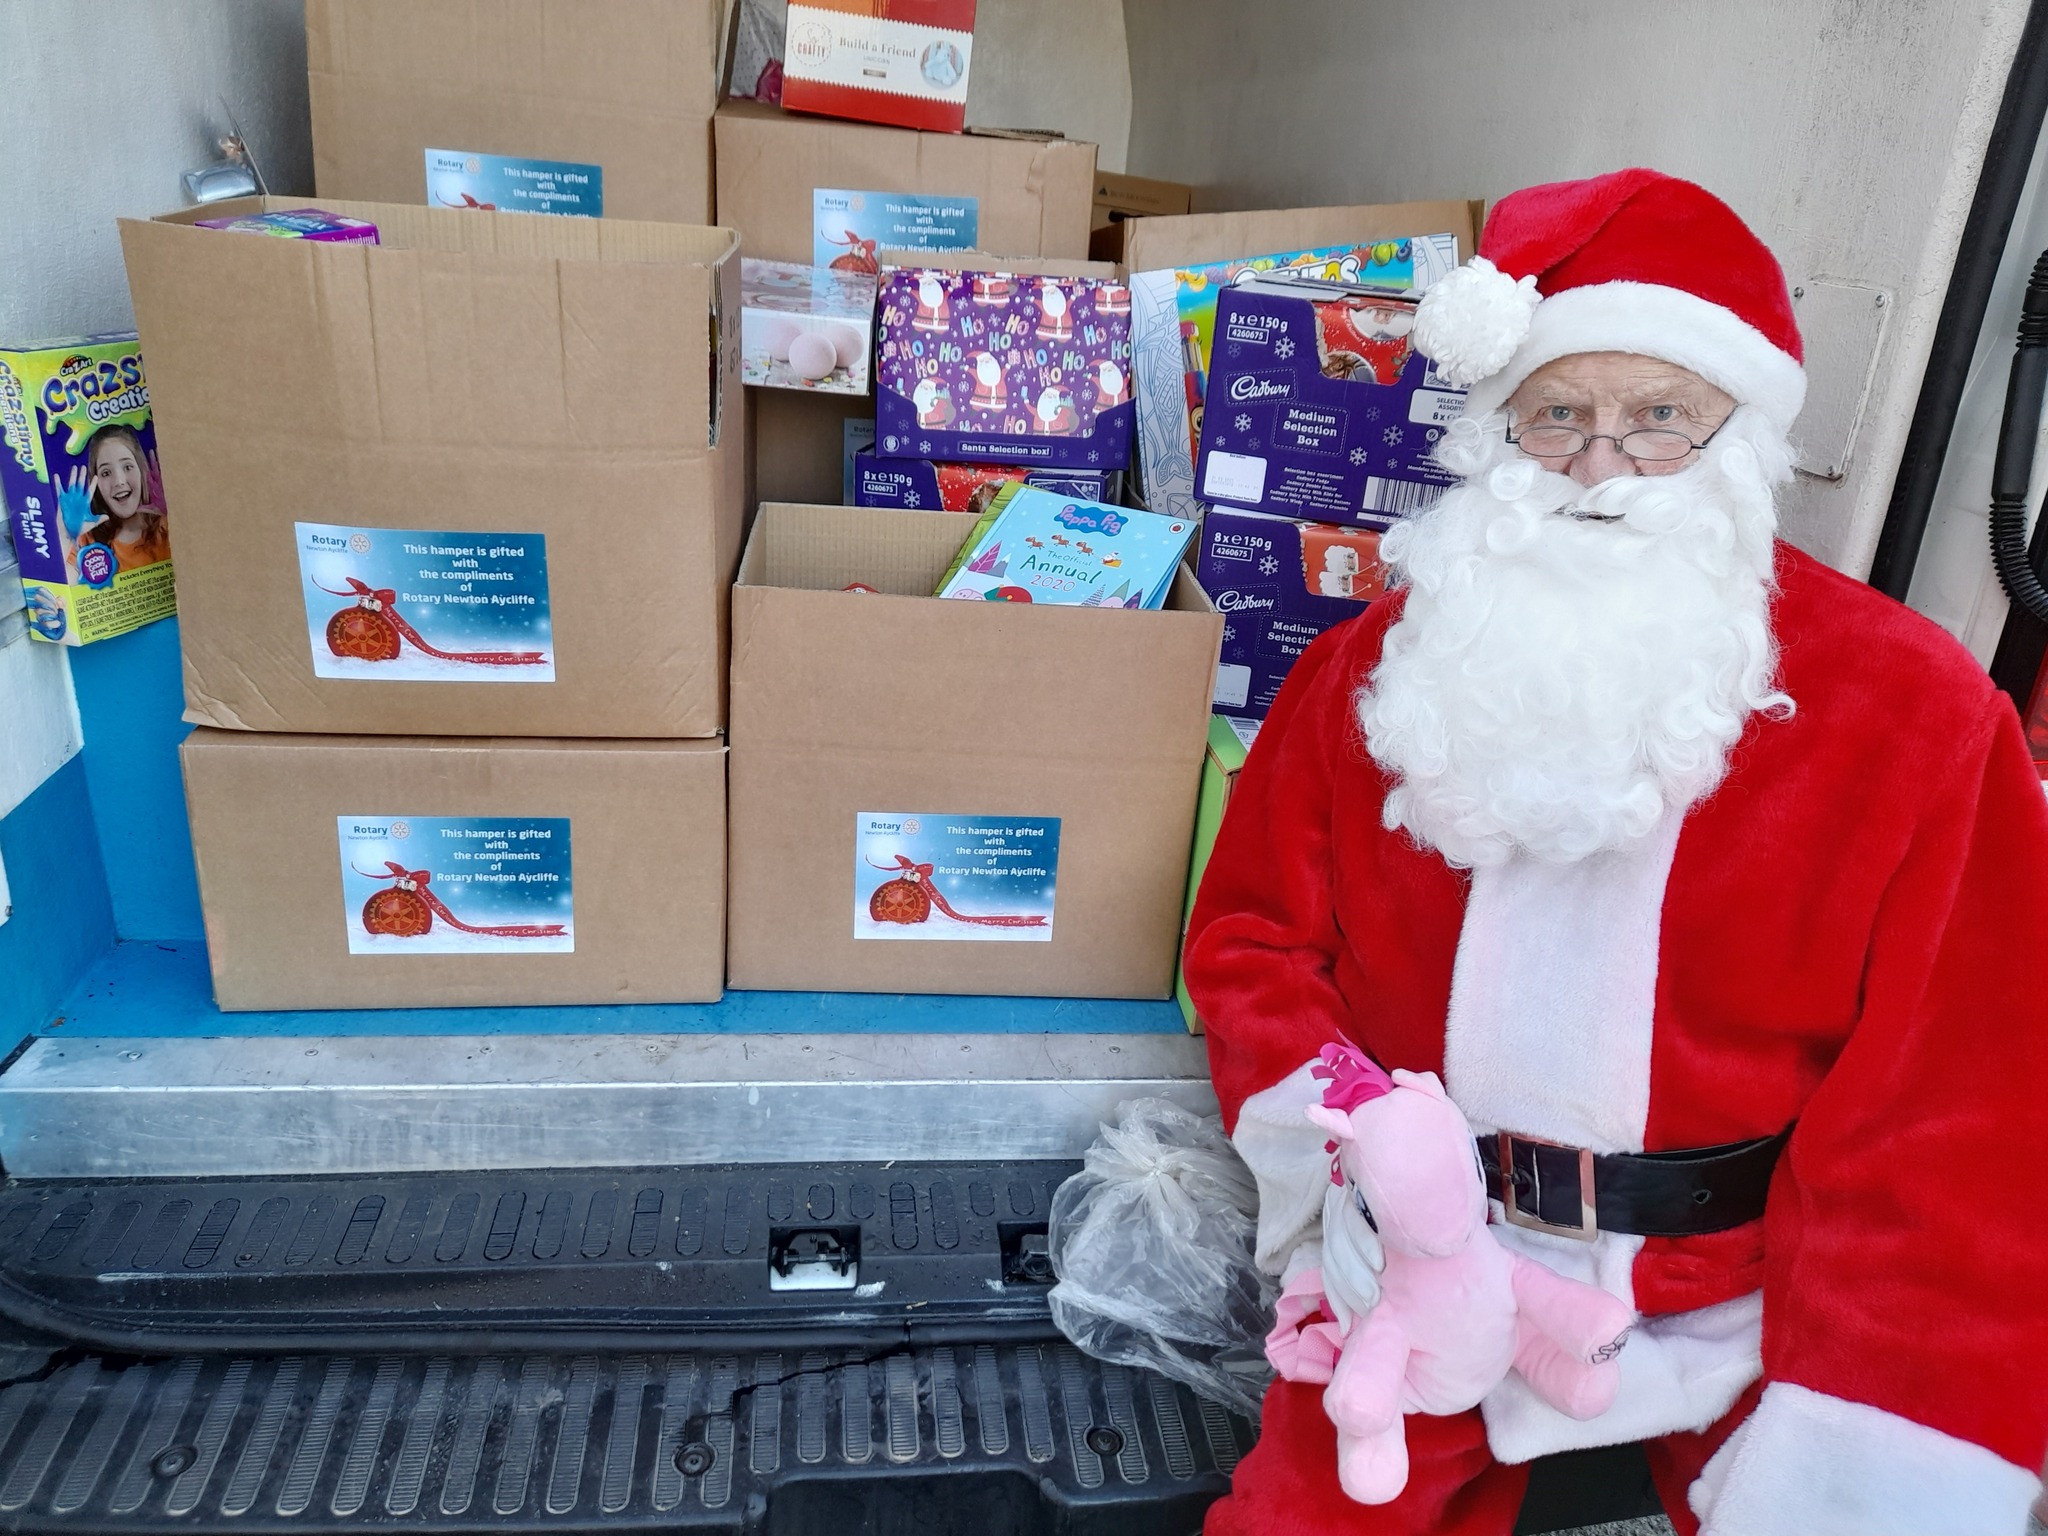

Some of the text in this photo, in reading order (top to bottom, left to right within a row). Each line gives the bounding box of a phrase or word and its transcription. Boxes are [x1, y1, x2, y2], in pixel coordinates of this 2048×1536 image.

[798, 42, 825, 58] CRAFTY
[840, 38, 869, 51] Build
[882, 44, 916, 58] Friend
[438, 159, 464, 169] Rotary
[503, 167, 588, 183] This hamper is gifted
[513, 189, 581, 203] the compliments
[825, 198, 849, 208] Rotary
[542, 201, 551, 209] of
[886, 204, 901, 213] This
[903, 205, 931, 215] hamper
[941, 208, 965, 218] gifted
[908, 226, 956, 236] compliments
[881, 304, 906, 327] HO
[961, 316, 985, 338] HO
[1005, 313, 1029, 336] HO
[989, 331, 1012, 352] HO
[1084, 324, 1107, 346] HO
[1231, 328, 1264, 341] 4260675
[899, 340, 924, 361] HO
[939, 342, 962, 362] HO
[1023, 348, 1048, 370] HO
[1062, 350, 1086, 371] HO
[915, 357, 939, 379] HO
[1039, 366, 1062, 387] HO
[1231, 375, 1291, 400] Cadbury
[1288, 409, 1336, 424] Medium
[1003, 415, 1027, 435] HO
[1283, 420, 1337, 437] Selection
[1297, 436, 1320, 447] Box
[962, 443, 1050, 456] Santa Selection box!
[867, 484, 894, 493] 4260675
[20, 512, 33, 540] Fun!
[1060, 505, 1121, 534] Peppa Pig
[26, 496, 50, 559] SLIMY
[312, 535, 347, 548] Rotary
[403, 544, 524, 558] This hamper is gifted
[1216, 547, 1248, 558] 4260675
[452, 558, 479, 568] with
[1048, 550, 1092, 567] The Official
[419, 569, 514, 582] the compliments
[1020, 554, 1102, 584] Annual
[460, 582, 472, 592] of
[1031, 574, 1075, 592] 2020
[402, 593, 535, 606] Rotary Newton Aycliffe
[1216, 590, 1274, 613] Cadbury
[1272, 621, 1319, 635] Medium
[1281, 645, 1303, 655] Box
[354, 826, 388, 836] Rotary
[871, 822, 901, 831] Rotary
[947, 826, 1044, 838] This hamper is gifted
[441, 829, 551, 840] This hamper is gifted
[485, 841, 508, 850] with
[973, 848, 1032, 857] compliments
[474, 852, 540, 862] compliments
[987, 858, 997, 866] of
[491, 862, 502, 871] of
[939, 866, 1046, 877] Rotary Newton Aycliffe
[437, 873, 559, 884] Rotary Newton Aycliffe
